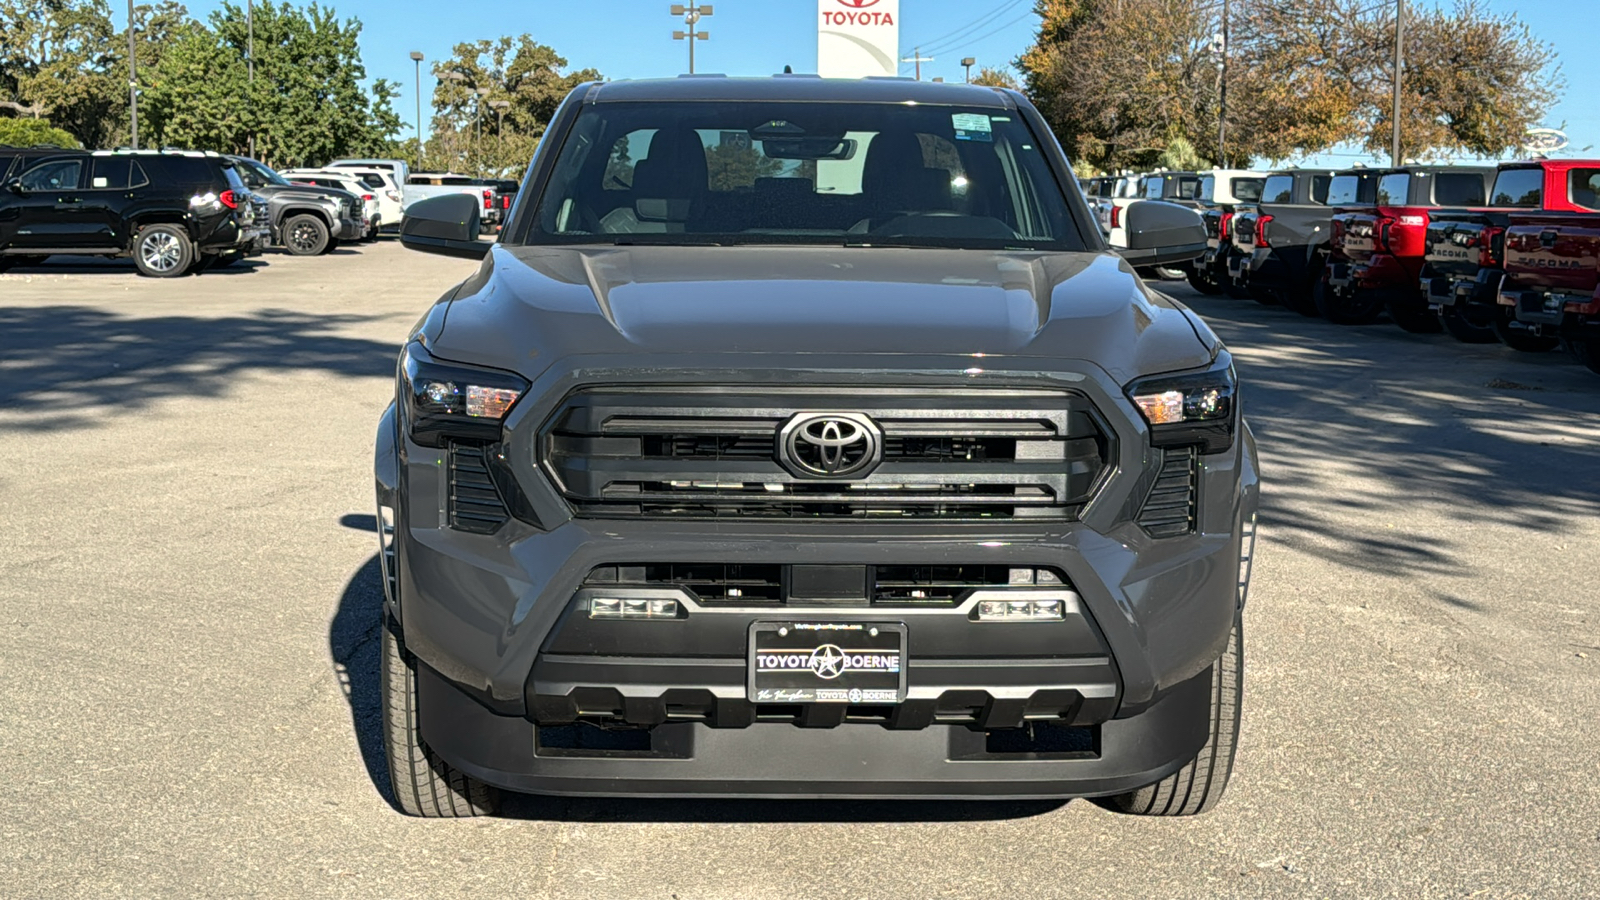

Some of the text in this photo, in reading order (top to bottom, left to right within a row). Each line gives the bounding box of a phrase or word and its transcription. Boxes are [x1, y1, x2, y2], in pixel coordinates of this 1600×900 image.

[822, 11, 893, 26] TOYOTA
[1432, 249, 1468, 258] TACOMA
[1519, 257, 1580, 269] TACOMA
[757, 655, 900, 668] TOYOTA BOERNE
[816, 691, 849, 700] TOYOTA
[862, 691, 897, 700] BOERNE
